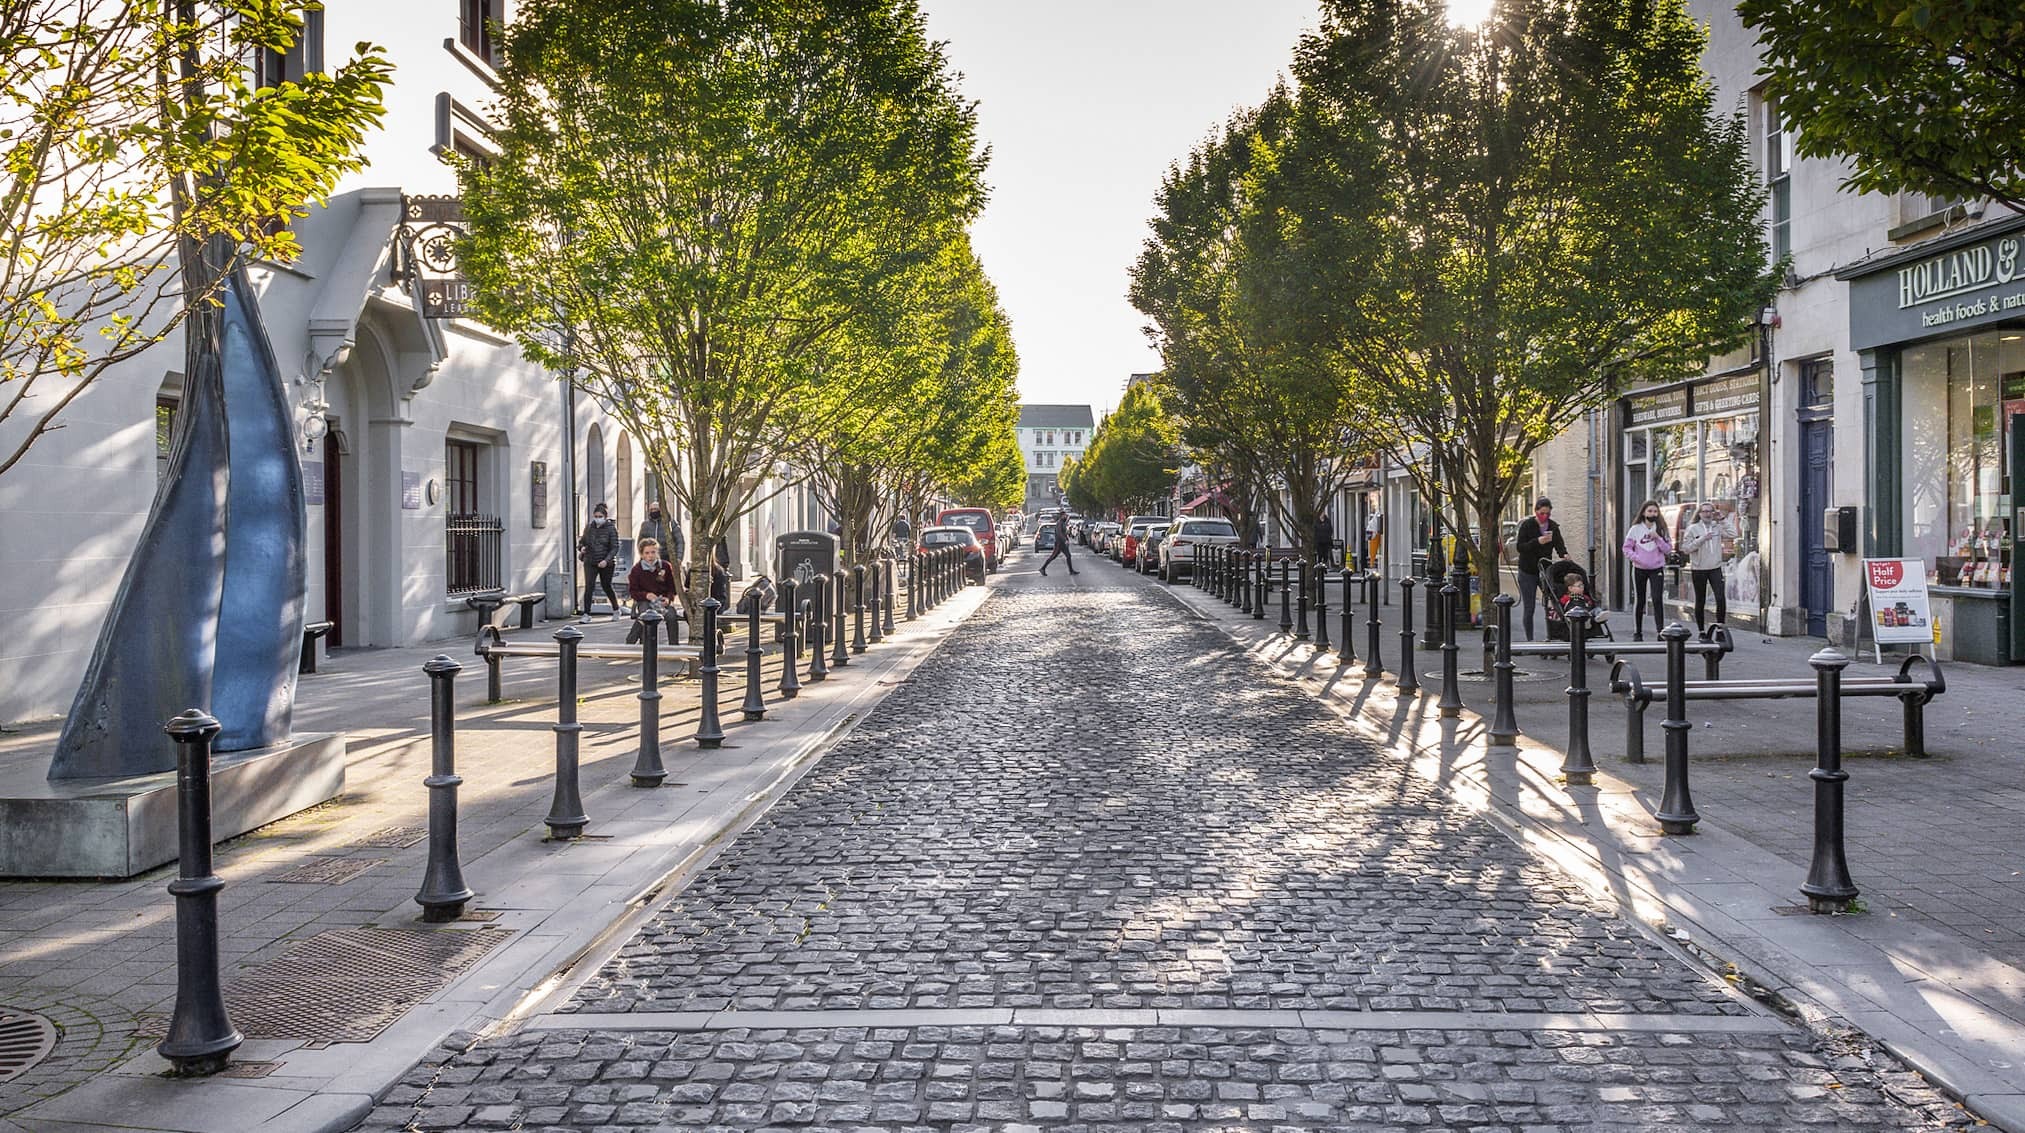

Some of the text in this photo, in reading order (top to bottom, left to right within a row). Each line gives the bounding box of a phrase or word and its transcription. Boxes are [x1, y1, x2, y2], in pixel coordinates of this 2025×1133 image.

[1898, 239, 2019, 309] HOLLAND &
[1922, 305, 1954, 328] health
[1955, 299, 1986, 321] foods
[1989, 295, 2000, 313] &
[1872, 566, 1894, 576] Half
[1874, 576, 1897, 585] Price
